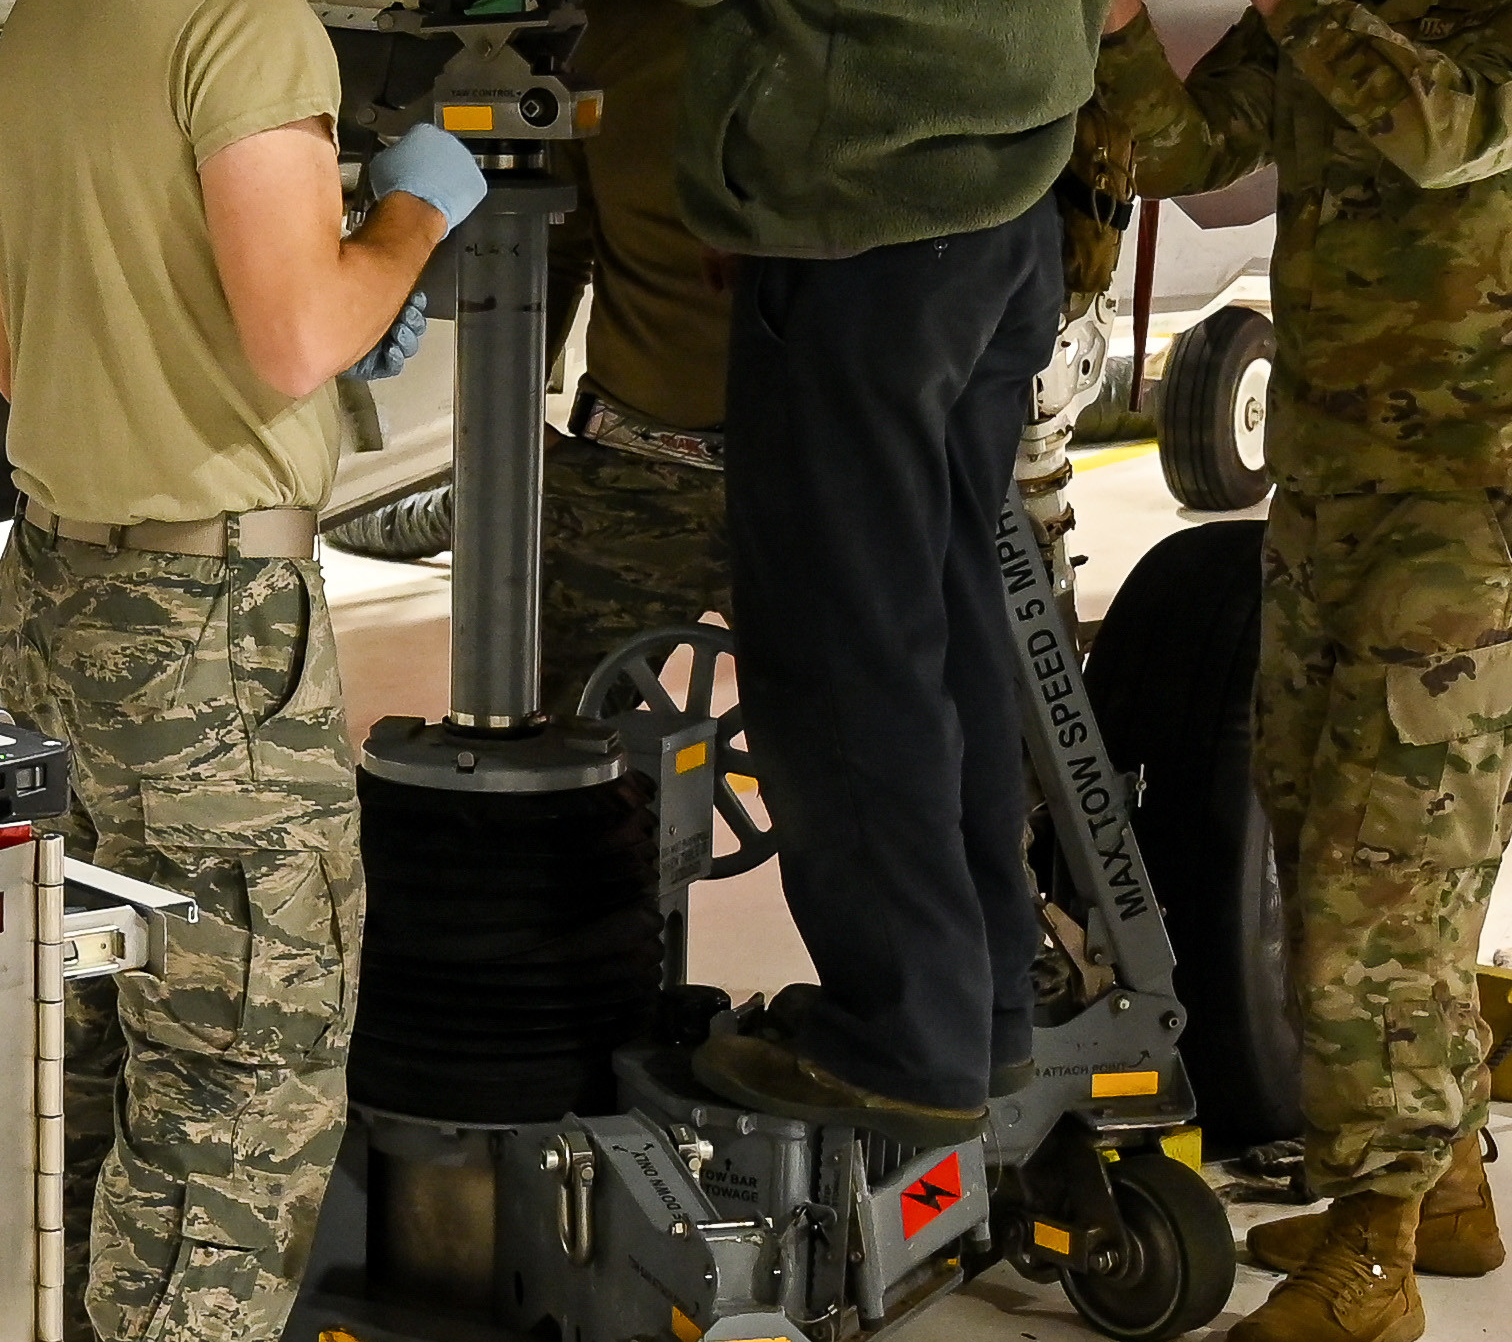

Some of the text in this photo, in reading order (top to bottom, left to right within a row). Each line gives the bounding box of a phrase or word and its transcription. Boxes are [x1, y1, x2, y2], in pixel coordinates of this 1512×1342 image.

[1015, 598, 1046, 623] 5
[1028, 628, 1088, 749] SPEED
[1067, 756, 1118, 841] TOW
[1098, 839, 1148, 921] MAX
[1043, 1065, 1089, 1078] ATTACH
[703, 1168, 757, 1189] OW BAR
[705, 1184, 759, 1202] TOWAGE
